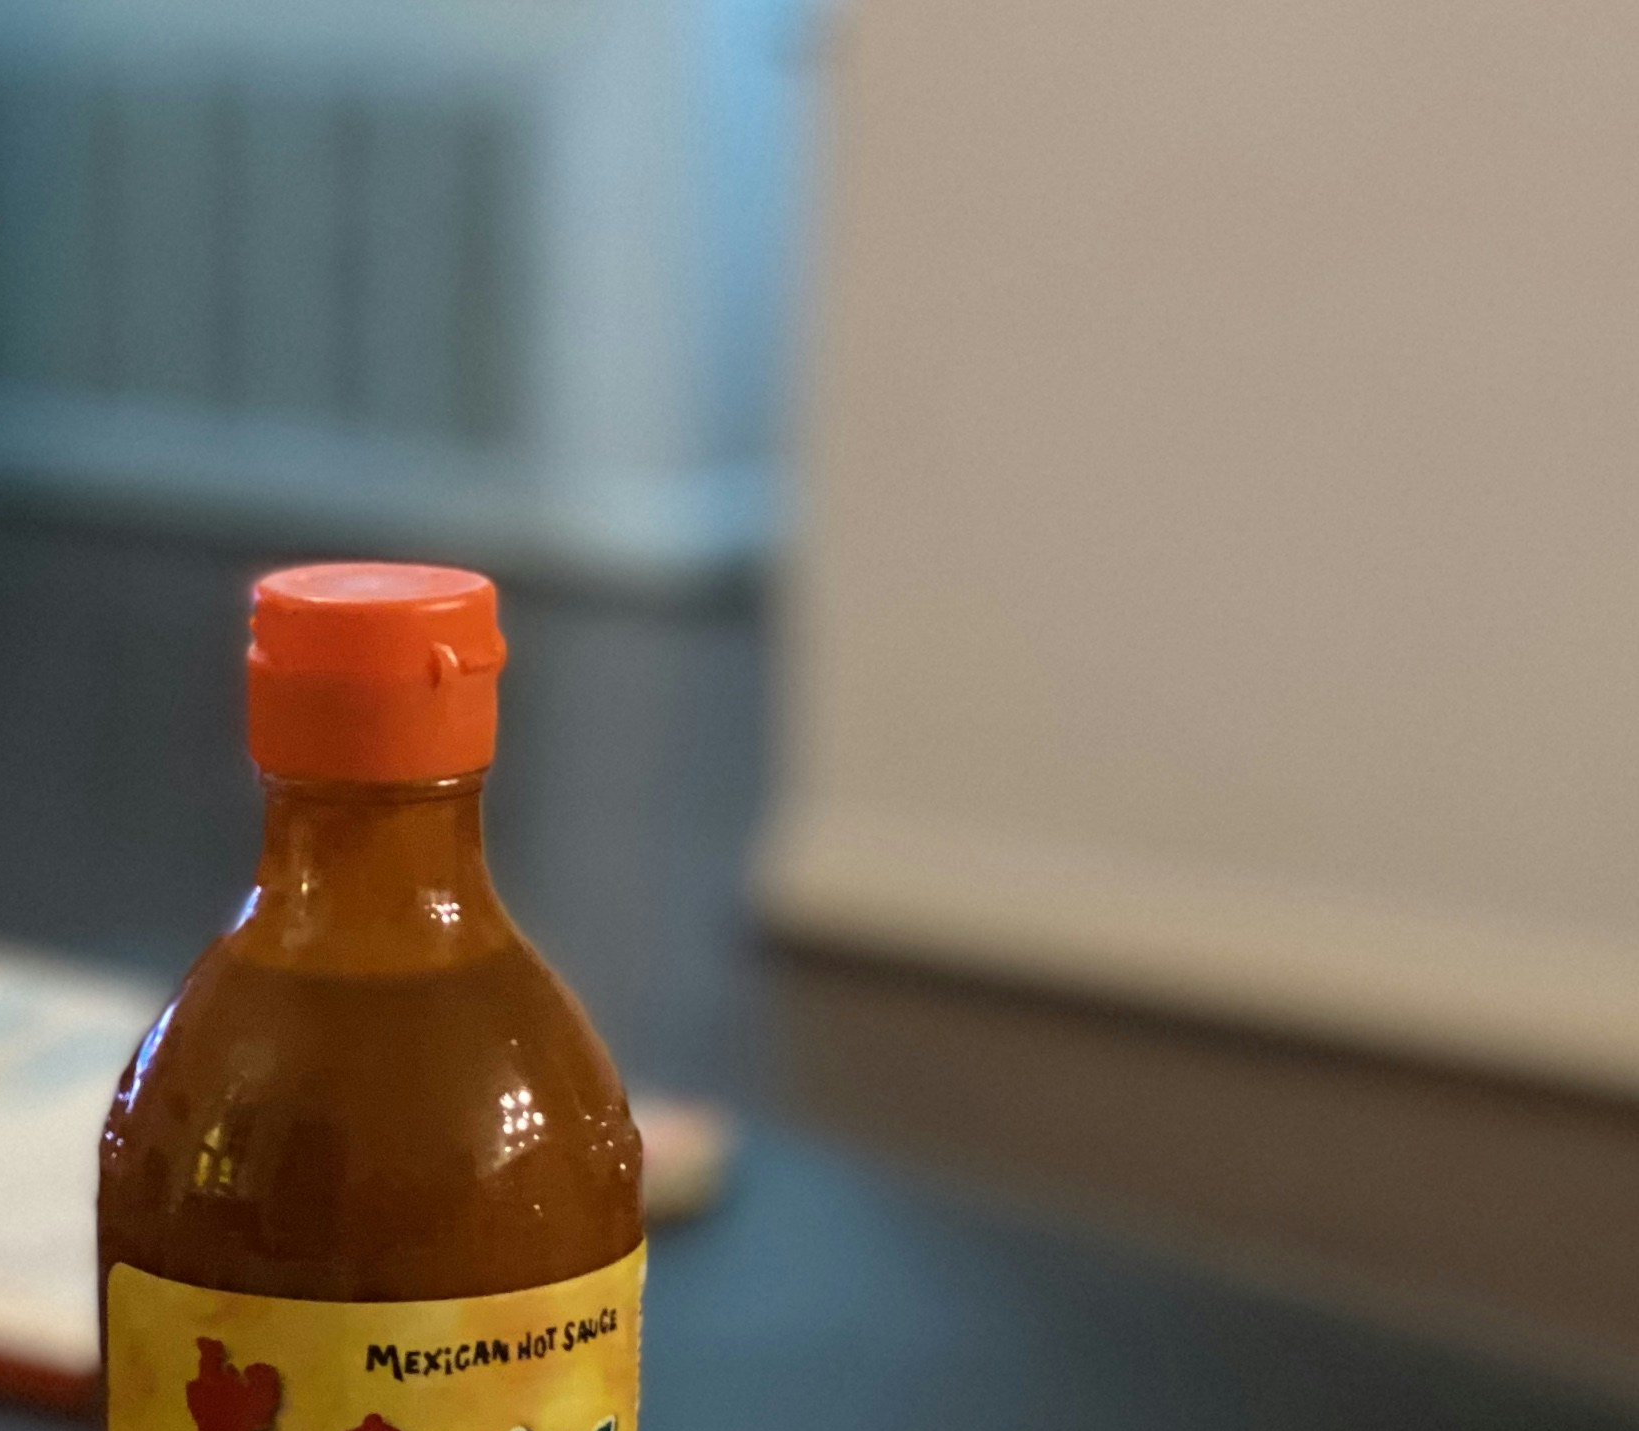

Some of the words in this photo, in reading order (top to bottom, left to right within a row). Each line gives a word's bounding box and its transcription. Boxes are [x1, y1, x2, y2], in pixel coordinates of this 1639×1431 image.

[366, 1336, 510, 1382] MEXICAN
[517, 1325, 558, 1361] HOT
[562, 1306, 619, 1352] SAUCE
